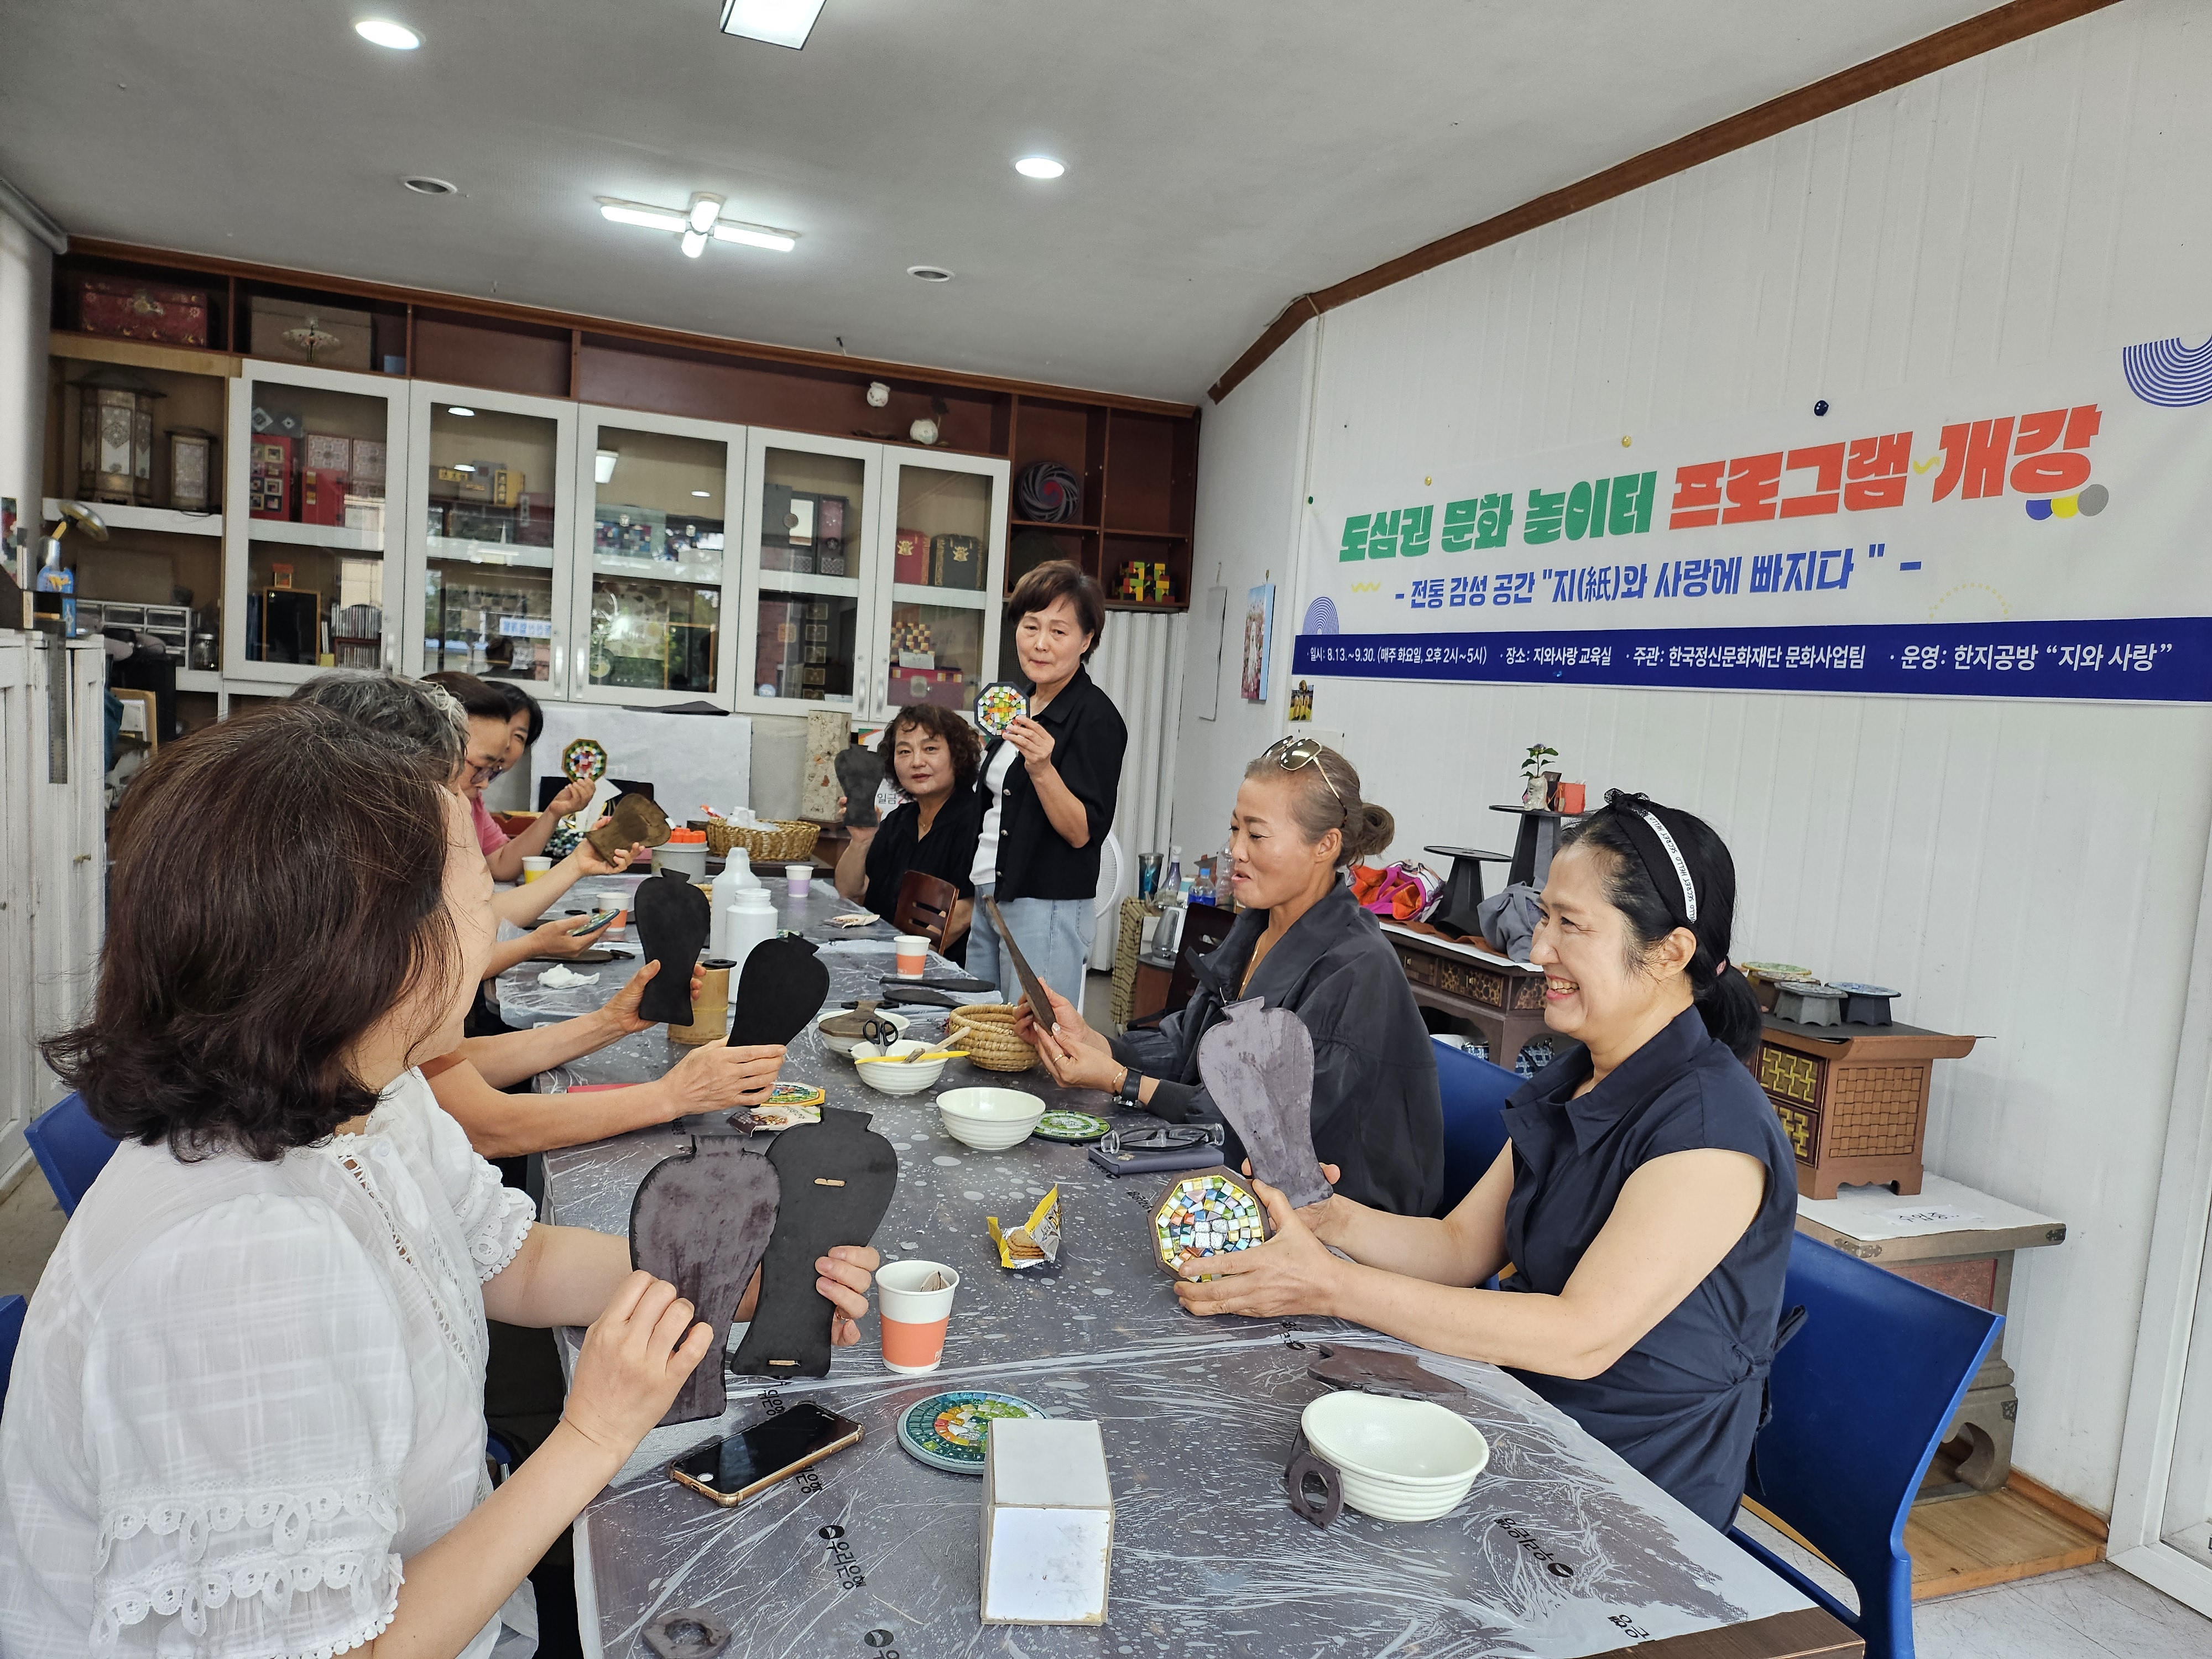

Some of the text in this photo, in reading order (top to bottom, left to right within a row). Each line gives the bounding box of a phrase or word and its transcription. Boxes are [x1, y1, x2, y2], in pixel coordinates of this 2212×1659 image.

[1339, 404, 2102, 562] 도심권 문화 놀이터 프로그램 개강
[1411, 579, 1444, 608] 전통
[1450, 575, 1487, 607] 감성
[1493, 572, 1535, 606] 공간
[1654, 556, 1742, 597] 사랑에
[1750, 549, 1854, 592] 빠지다
[1310, 646, 1325, 662] 일시:
[1377, 646, 1396, 664] (매주
[1397, 646, 1423, 665] 화요일,
[1425, 646, 1442, 664] 오후
[1506, 646, 1530, 665] 장소:
[1533, 646, 1578, 666] 지와사랑
[1578, 646, 1612, 666] 교육실
[1633, 646, 1665, 666] 주관:
[1669, 645, 1782, 668] 한국정신문화재단
[1785, 645, 1866, 669] 문화사업팀
[1901, 645, 1947, 670] 운영:
[1954, 644, 2039, 671] 한지공방
[1649, 817, 1665, 832] HELLO
[1660, 832, 1678, 854] SECRET
[1676, 857, 1688, 877] HELLO
[1683, 878, 1694, 902] SECRET
[1494, 1517, 1554, 1562] 우리은행
[826, 1541, 867, 1590] 우리은행
